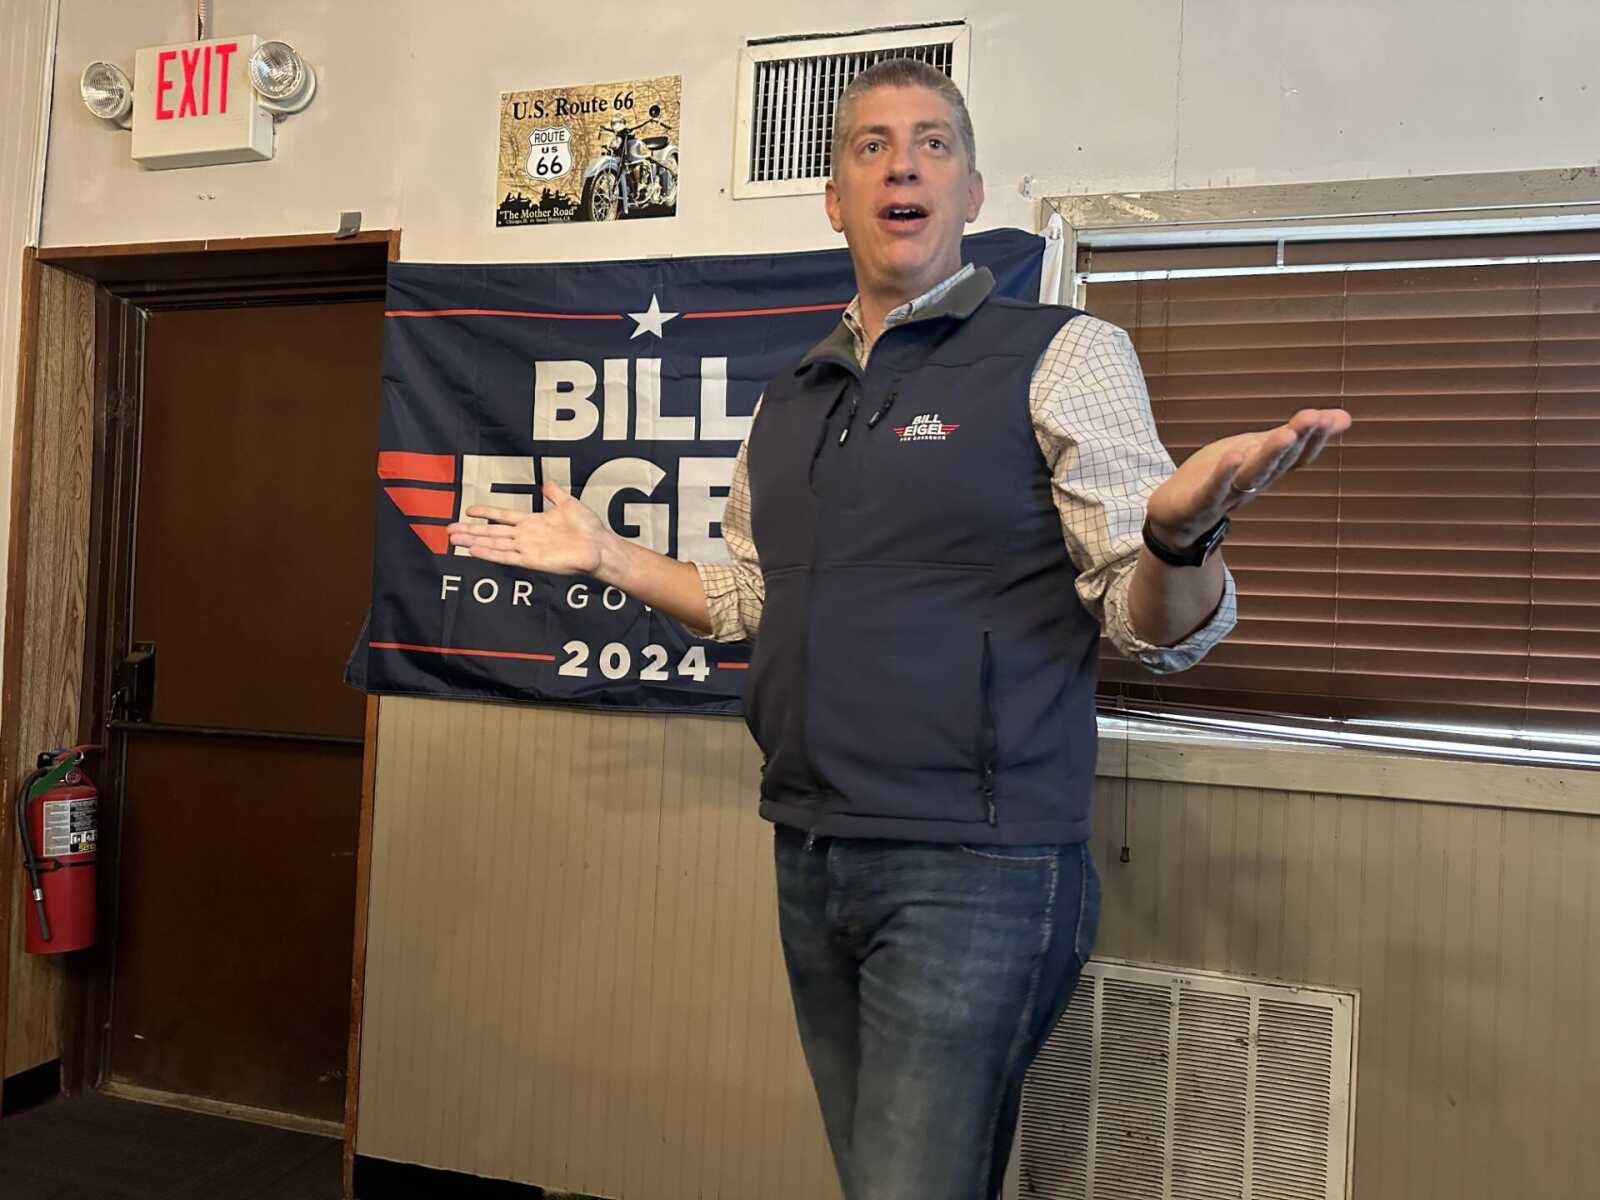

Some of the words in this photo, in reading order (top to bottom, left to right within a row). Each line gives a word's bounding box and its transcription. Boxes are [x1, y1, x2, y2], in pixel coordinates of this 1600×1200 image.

[156, 42, 238, 121] EXIT
[513, 100, 549, 120] U.S.
[555, 97, 608, 116] Route
[613, 91, 634, 110] 66
[534, 130, 566, 143] ROUTE
[536, 156, 563, 176] 66
[499, 210, 519, 220] "The
[520, 208, 551, 218] Mother
[553, 206, 578, 217] Road"
[532, 356, 754, 441] BILL
[903, 423, 946, 436] EIGEL
[912, 413, 941, 425] BILL
[453, 454, 738, 561] EGE
[440, 575, 533, 606] FOR
[558, 640, 710, 682] 2024
